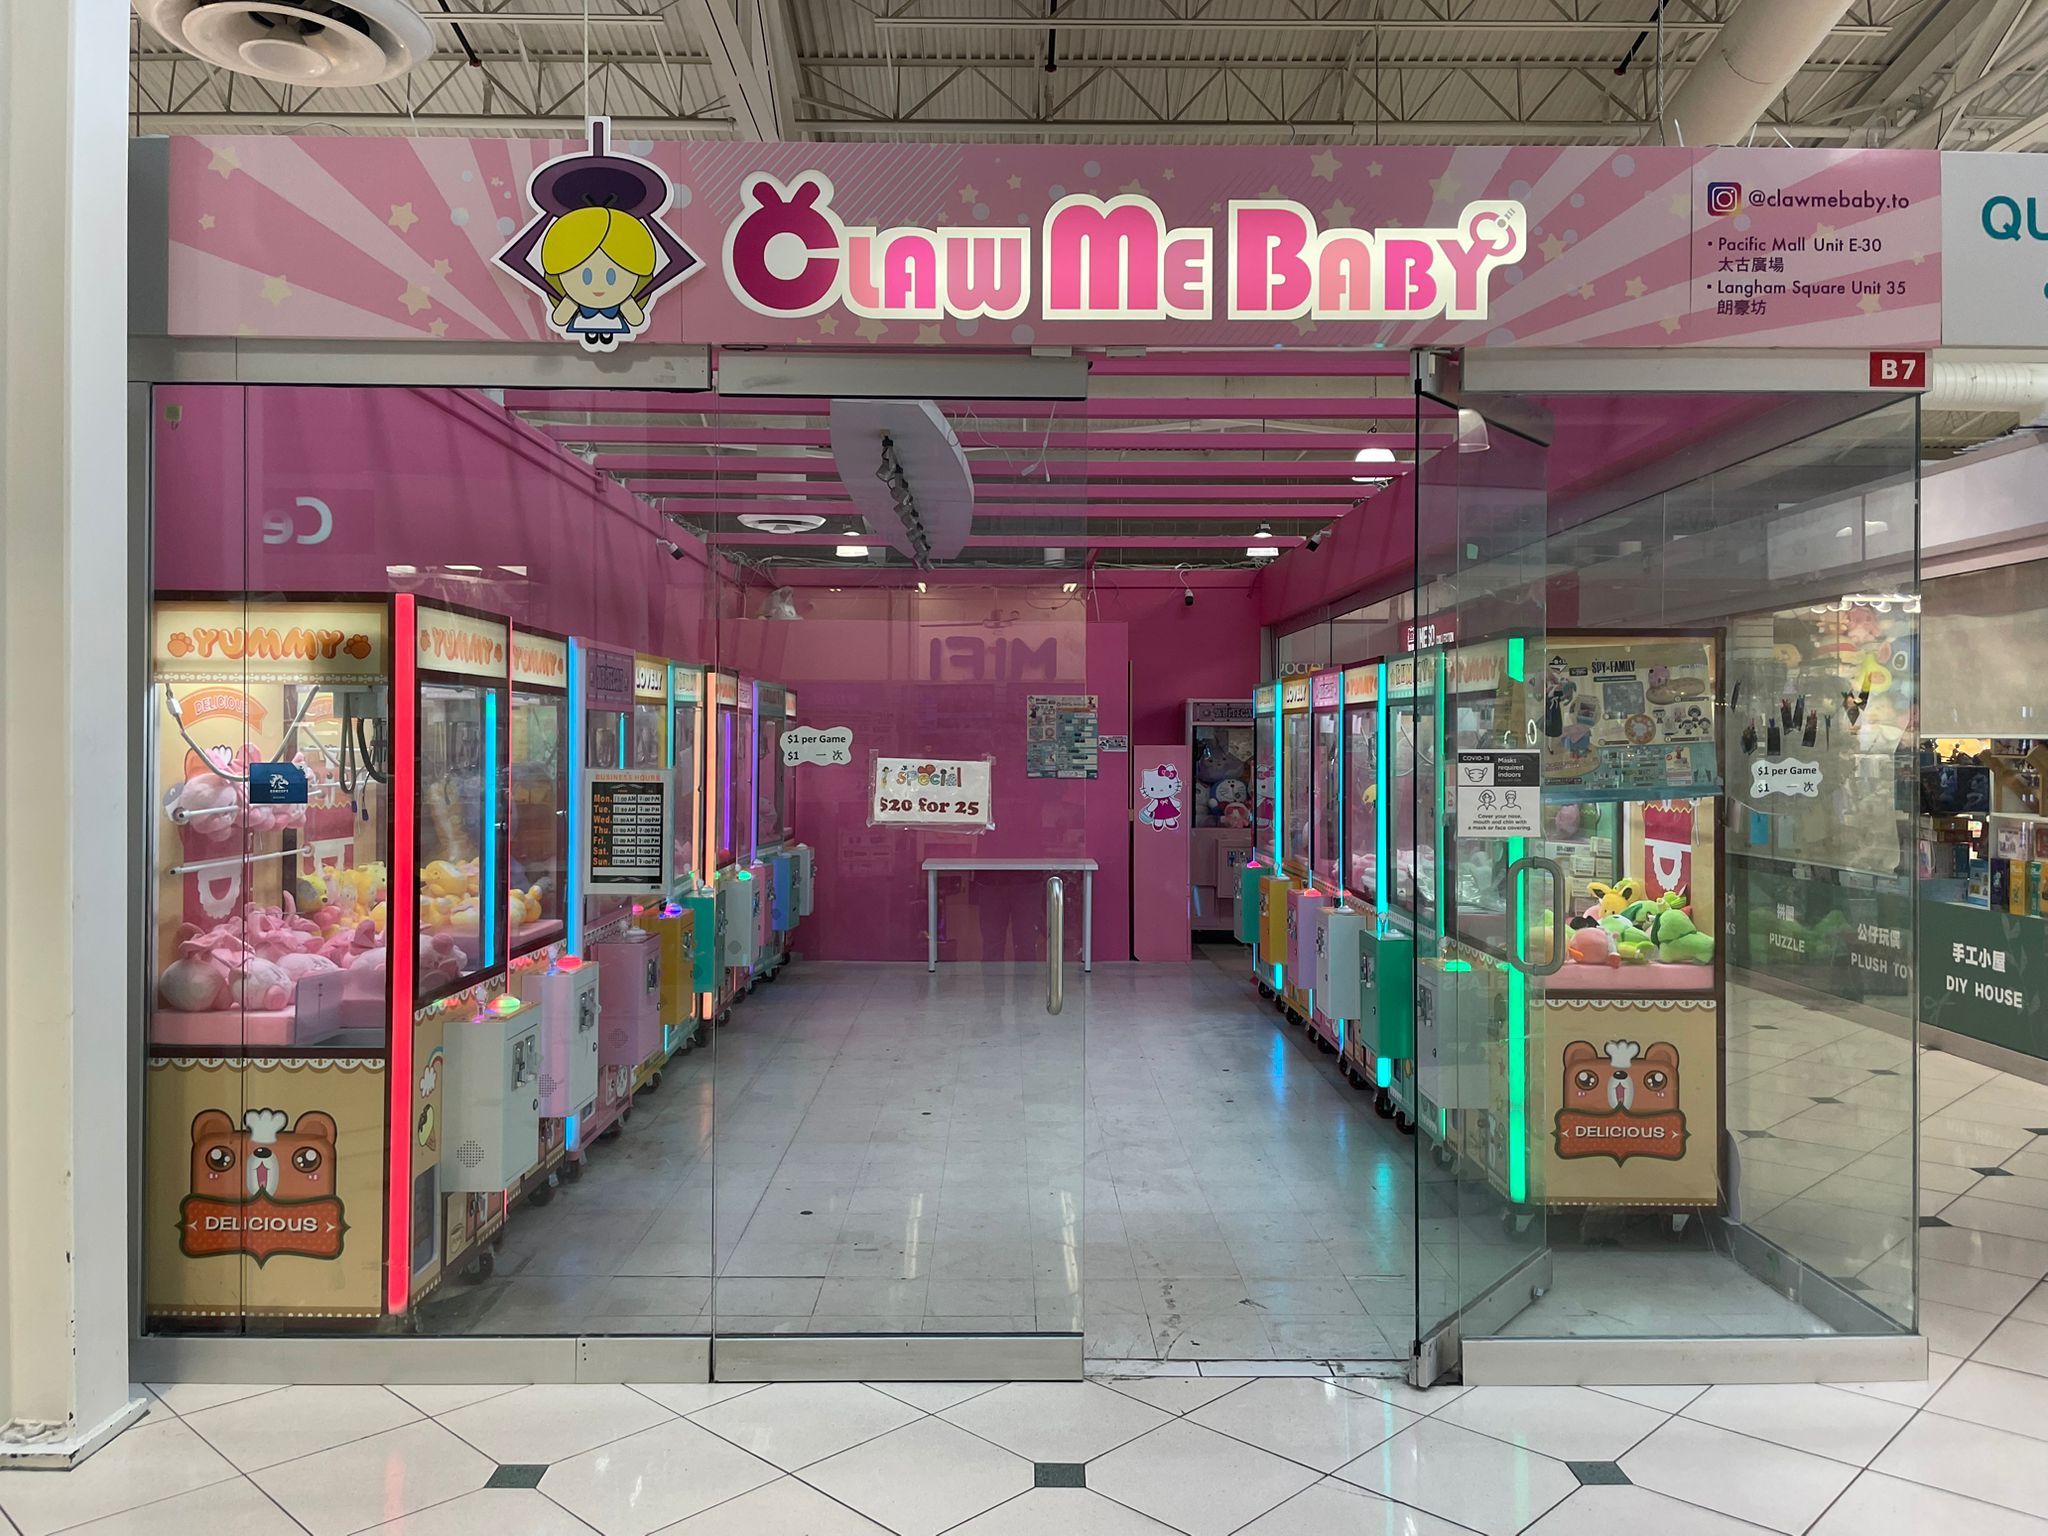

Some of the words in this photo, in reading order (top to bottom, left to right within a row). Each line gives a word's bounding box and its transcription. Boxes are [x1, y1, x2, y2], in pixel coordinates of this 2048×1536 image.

[1748, 189, 1910, 213] @clawmebaby.to
[1718, 236, 1767, 252] Pacific
[1773, 236, 1805, 252] Mall
[1814, 238, 1844, 252] Unit
[1849, 238, 1882, 252] E-30
[1717, 256, 1784, 273] 太古廣場
[1717, 279, 1786, 298] Langham
[1792, 280, 1846, 298] Square
[1851, 281, 1882, 294] Unit
[1886, 281, 1906, 295] 35
[1717, 299, 1767, 316] 朗豪坊
[192, 626, 345, 661] YUMMY
[431, 626, 494, 665] YUMMY
[635, 666, 664, 691] LOVELY
[193, 695, 248, 716] DELICIOU
[787, 734, 799, 744] $1
[801, 735, 817, 745] per
[819, 734, 846, 743] Game
[787, 751, 799, 761] $1
[1757, 766, 1769, 776] $1
[1771, 767, 1787, 777] per
[1789, 766, 1817, 775] Game
[1757, 783, 1770, 793] $1
[593, 794, 613, 803] Mon.
[879, 796, 913, 813] $20
[918, 797, 950, 813] for
[954, 801, 979, 815] 25
[593, 804, 611, 813] Tue.
[593, 815, 613, 824] Wed.
[593, 825, 611, 834] Thu.
[593, 836, 607, 845] Fri.
[593, 847, 609, 855] Sat.
[593, 857, 610, 866] Sun.
[1769, 932, 1805, 953] PUZZLE
[1850, 952, 1888, 974] PLUSH
[1952, 942, 2006, 973] 手工小屋
[1946, 974, 1968, 994] DIY
[1975, 981, 2023, 1009] HOUSE
[1575, 1125, 1666, 1139] DELICIOUS
[204, 1215, 319, 1232] DELICIOUS
